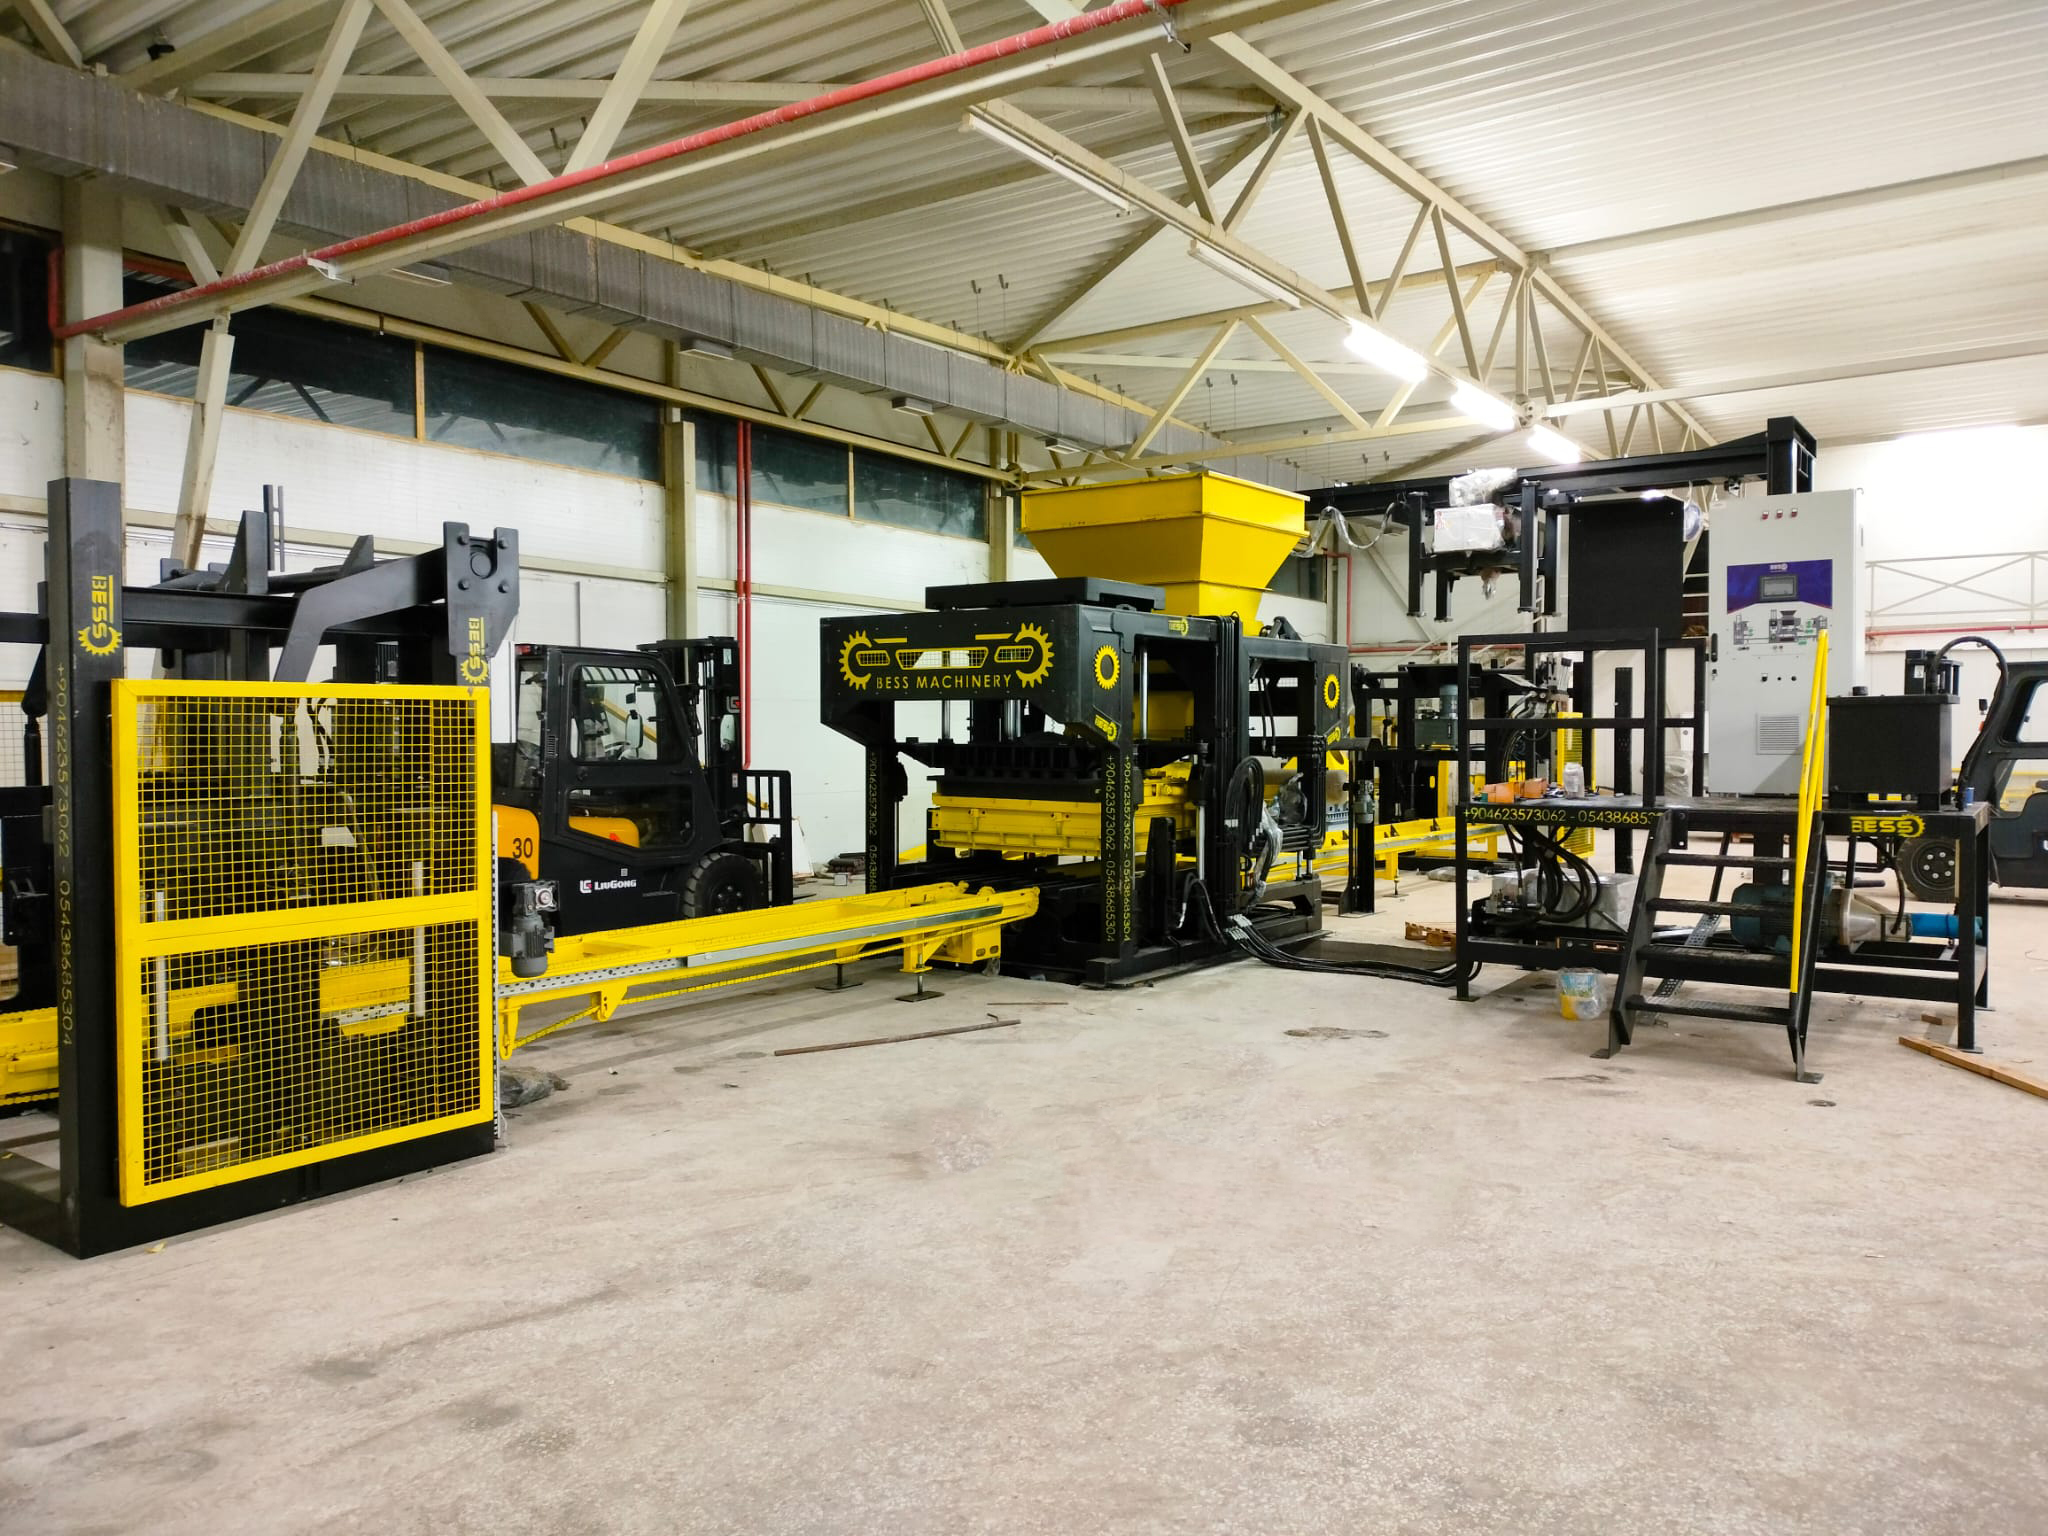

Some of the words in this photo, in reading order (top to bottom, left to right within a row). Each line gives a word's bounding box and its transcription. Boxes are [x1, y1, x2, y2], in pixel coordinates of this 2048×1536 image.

[92, 575, 108, 639] BESS
[468, 617, 480, 669] BESS
[876, 676, 908, 689] BESS
[916, 674, 1011, 689] MACHINERY
[55, 663, 70, 858] +904623573062
[1105, 756, 1116, 850] +904623573062
[1122, 755, 1132, 850] +904623573062
[1464, 807, 1566, 821] +904623573062
[1851, 820, 1914, 833] BESS
[512, 837, 534, 859] 30
[869, 844, 878, 893] 0543868
[1105, 860, 1117, 942] 05438685304
[1122, 860, 1132, 942] 05438685304
[58, 880, 73, 1045] 05438685304
